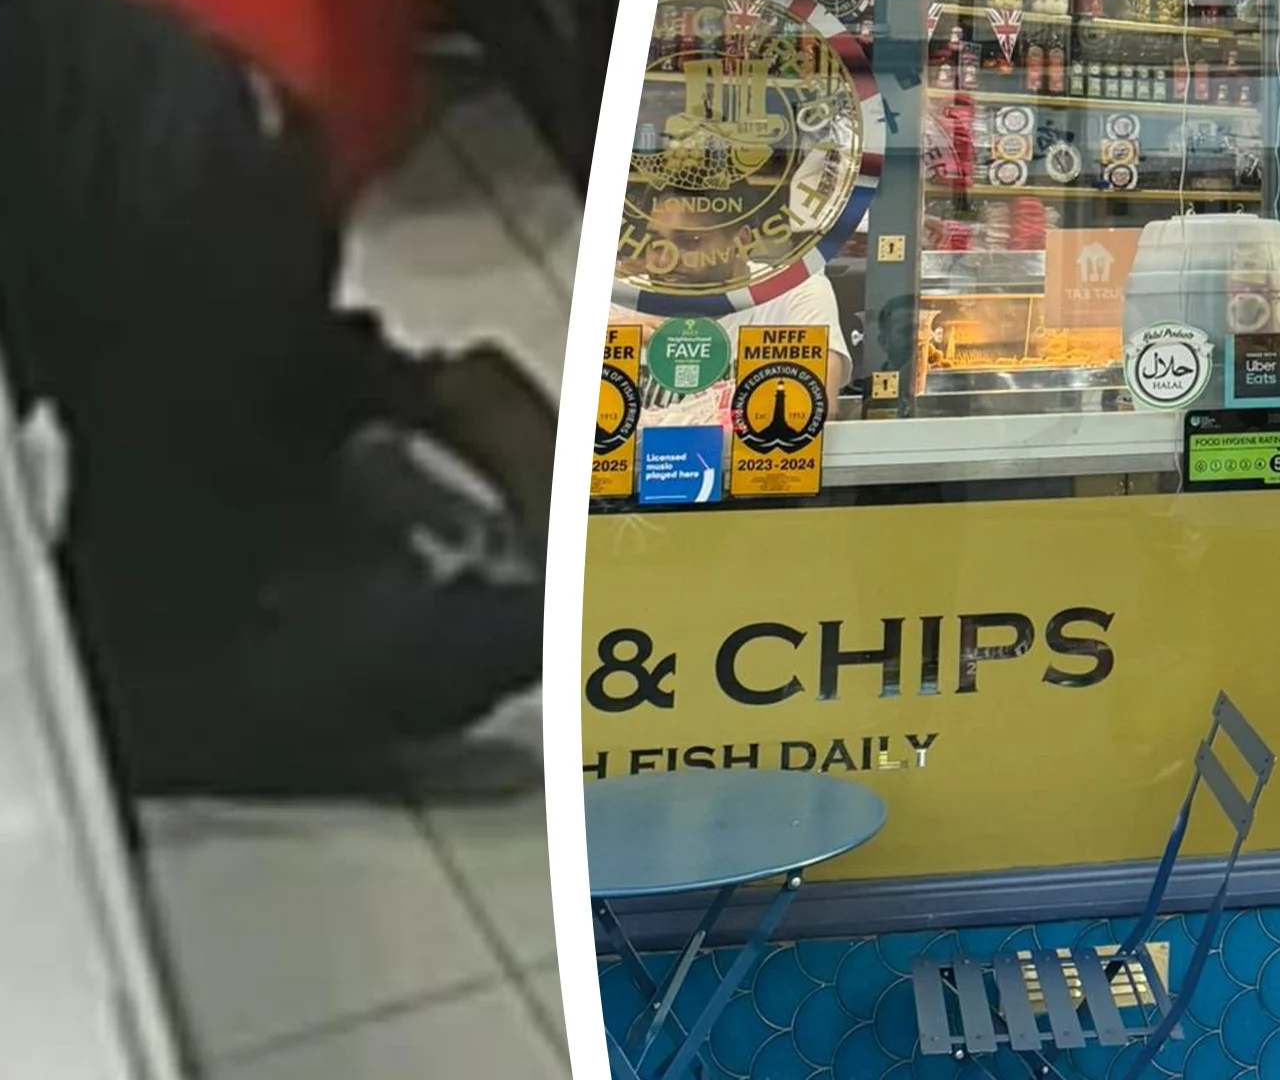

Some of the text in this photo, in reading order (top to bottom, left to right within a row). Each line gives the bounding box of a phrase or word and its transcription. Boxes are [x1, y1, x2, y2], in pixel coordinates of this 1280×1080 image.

[652, 196, 743, 213] LONDON
[735, 181, 830, 259] FISH
[763, 330, 807, 344] NFFF
[665, 343, 712, 359] FAVE
[743, 346, 823, 360] MEMBER
[1246, 360, 1277, 373] Uber
[745, 365, 798, 392] FEDERATION
[1246, 374, 1277, 385] Eats
[1152, 382, 1183, 390] HALAL
[1196, 436, 1221, 447] FOOD
[1222, 433, 1257, 446] HYGIENE
[646, 452, 687, 462] Licensed
[646, 462, 673, 471] music
[737, 458, 816, 472] 2023-2024
[645, 469, 700, 482] played here
[585, 606, 1116, 712] & CHIPS
[628, 743, 760, 776] FISH
[779, 733, 940, 774] DAILY
